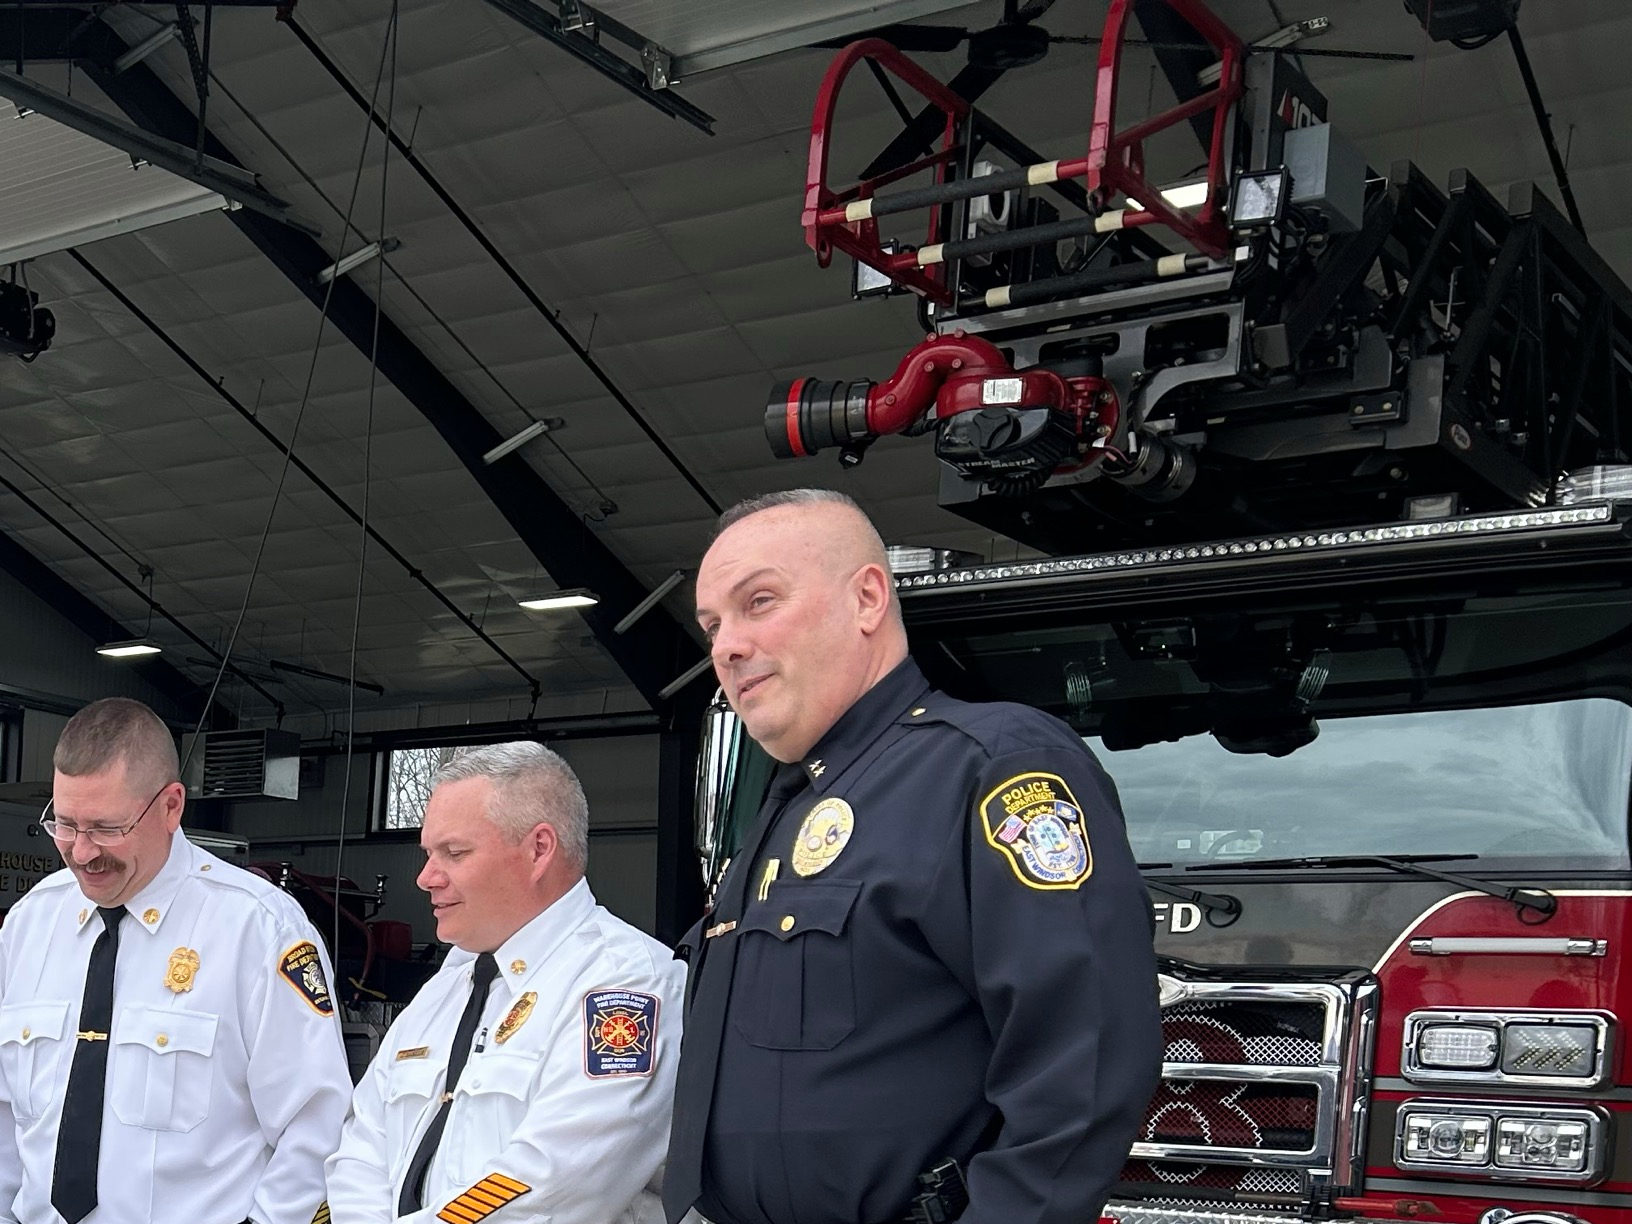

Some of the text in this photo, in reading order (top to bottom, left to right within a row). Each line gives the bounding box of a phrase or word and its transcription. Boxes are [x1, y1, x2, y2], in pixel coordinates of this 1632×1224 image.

[1001, 782, 1051, 805] POLICE
[1005, 792, 1056, 814] DEPARTMENT
[1023, 845, 1036, 865] EAST
[1031, 860, 1067, 880] WINDSOR
[15, 876, 37, 894] DI
[593, 993, 649, 1005] WAREHOUSE POINT
[609, 1000, 646, 1009] DEPARTMENT
